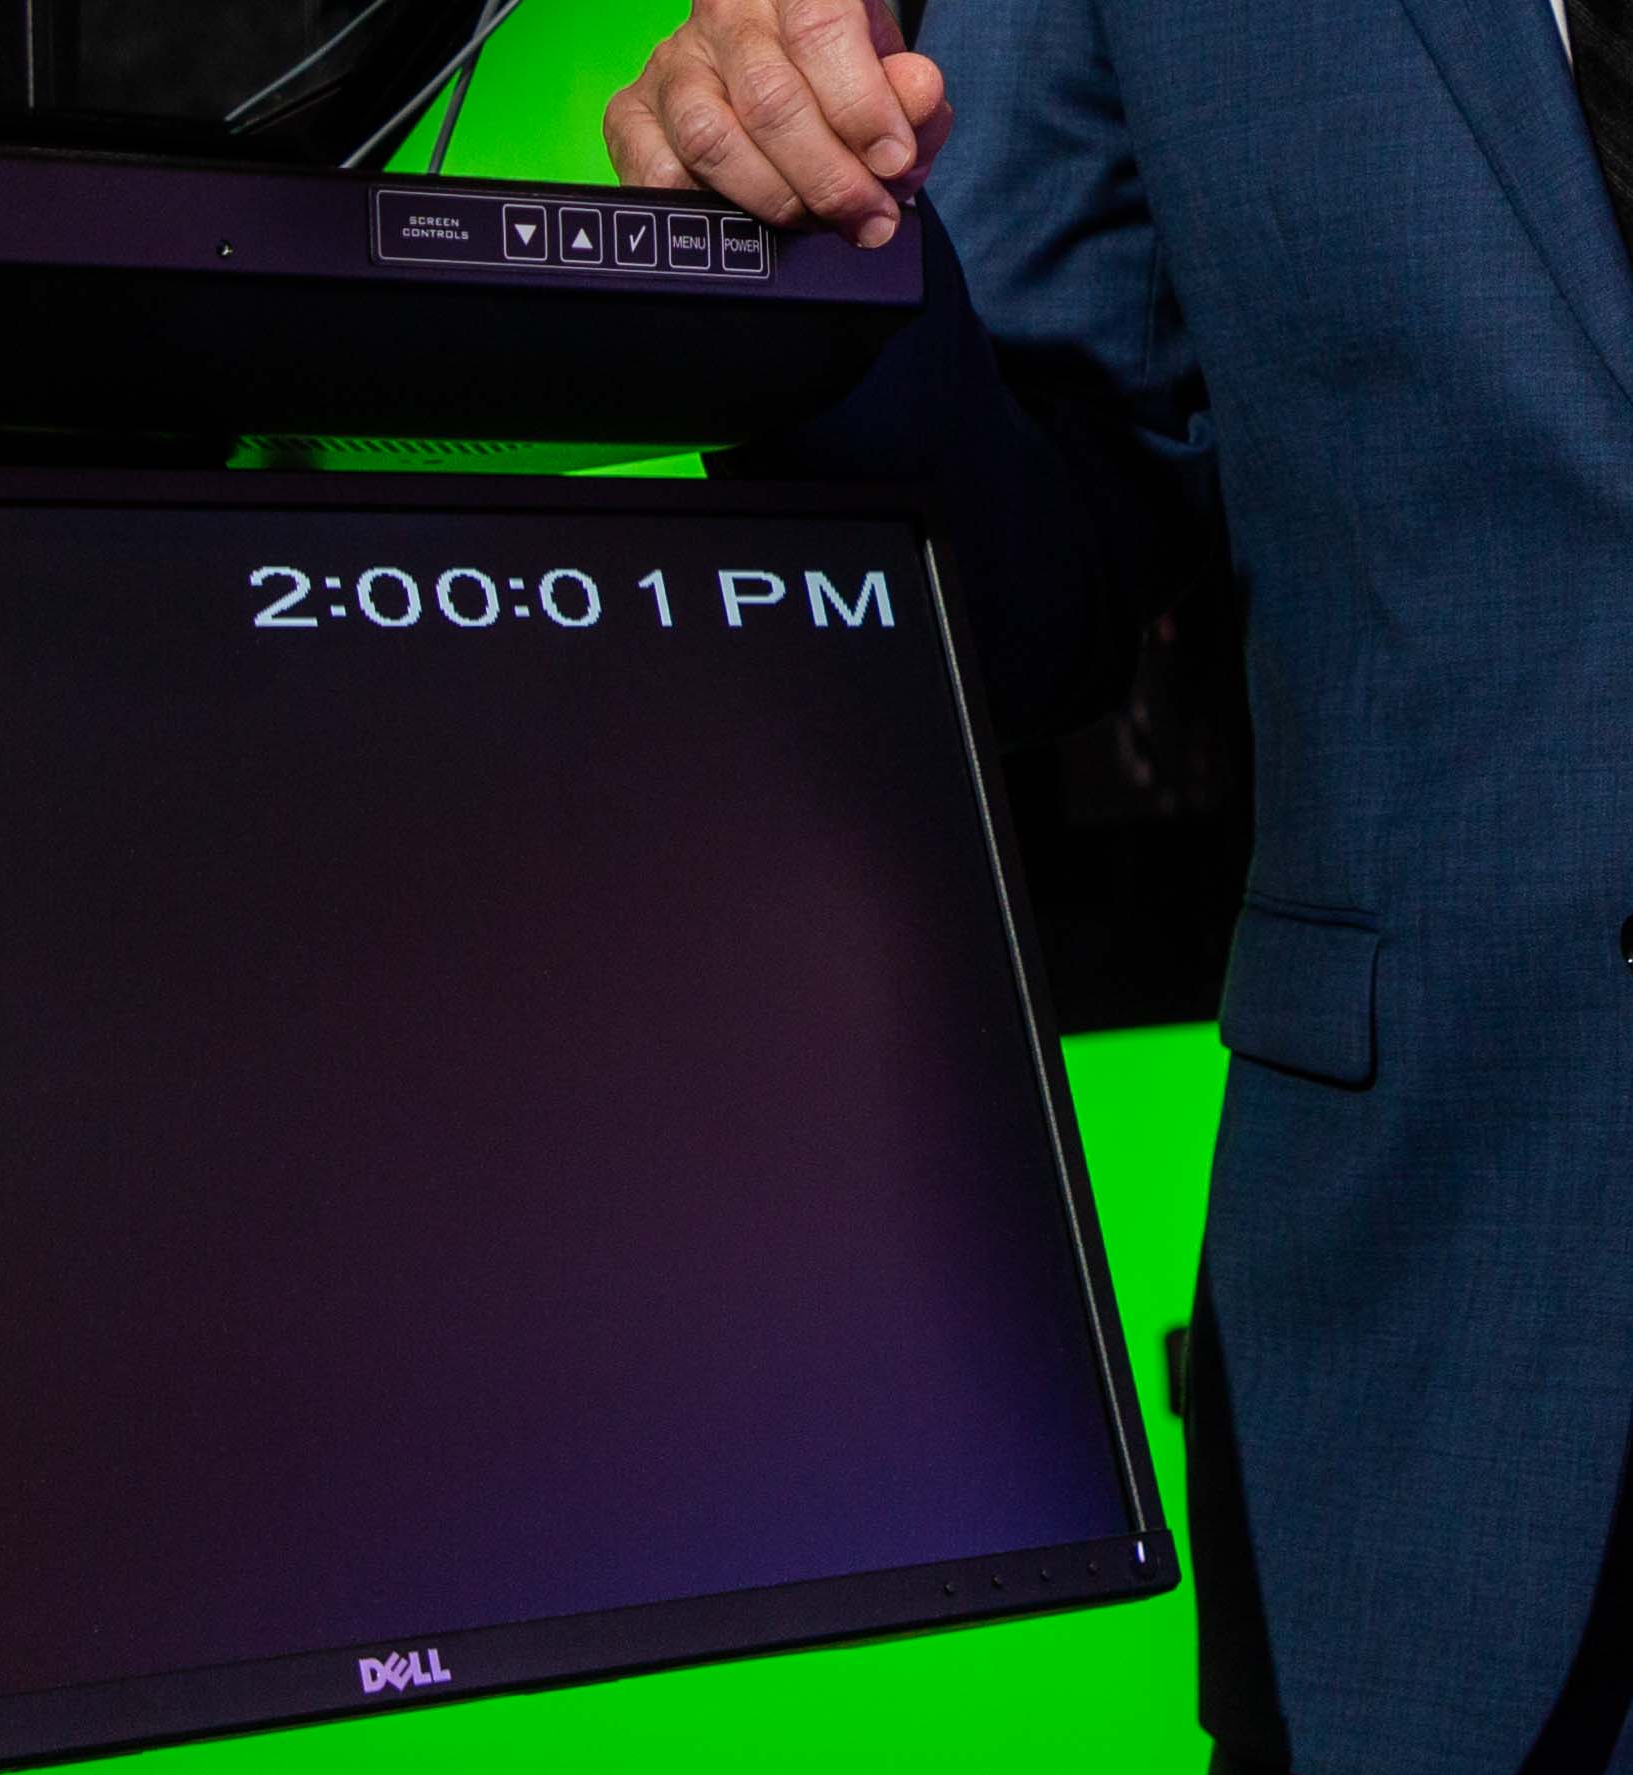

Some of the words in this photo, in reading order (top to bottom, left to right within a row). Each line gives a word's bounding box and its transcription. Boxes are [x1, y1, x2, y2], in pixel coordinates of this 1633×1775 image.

[408, 215, 460, 227] SCREEN
[402, 227, 470, 240] CONTROLS
[671, 235, 707, 250] MENU
[723, 237, 760, 253] POWER
[249, 565, 674, 627] 2:00:01
[717, 569, 896, 627] PM
[358, 1647, 453, 1695] DELL
